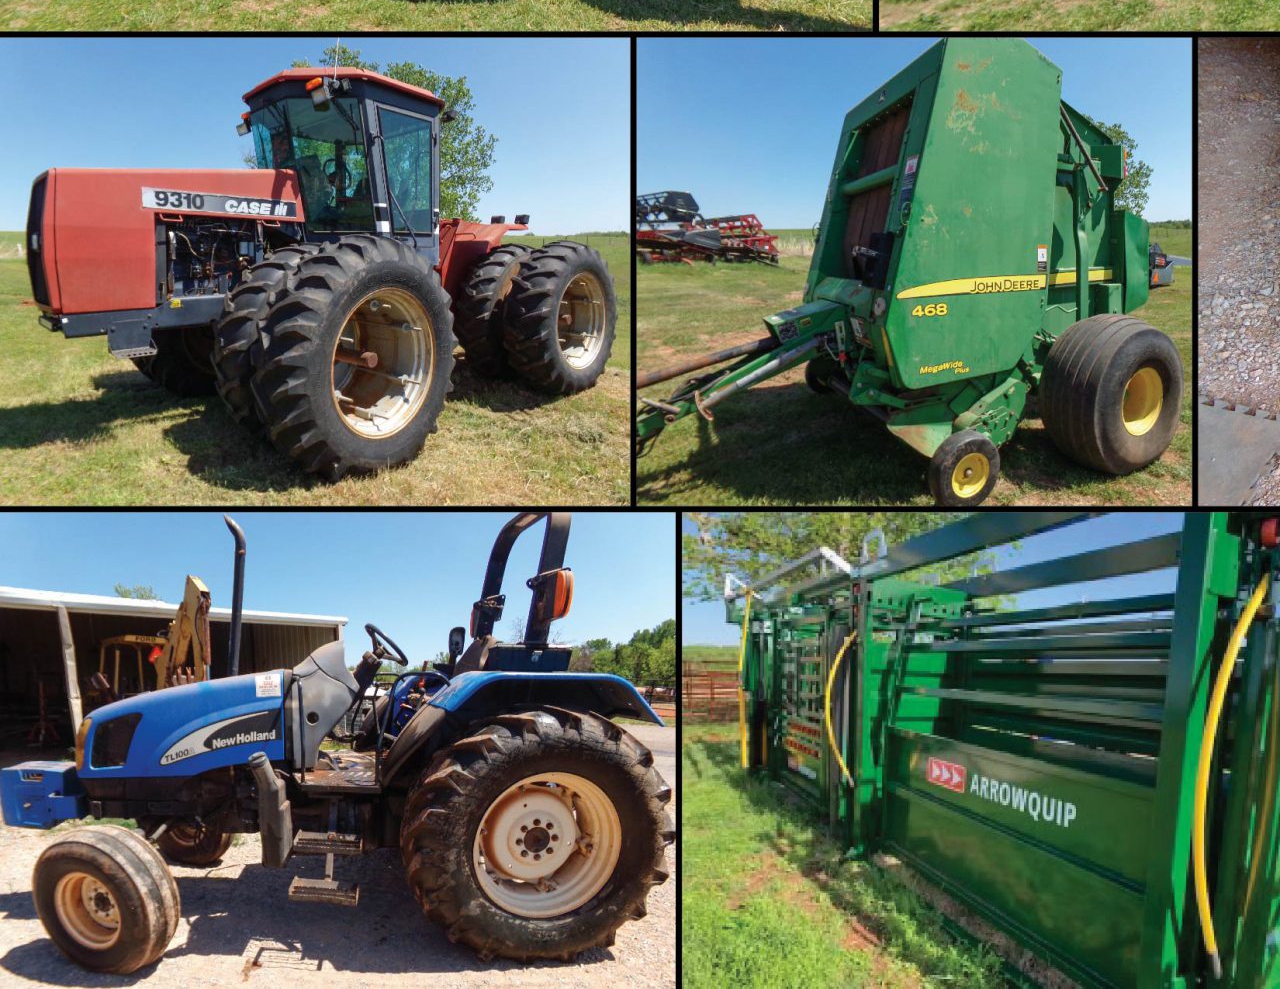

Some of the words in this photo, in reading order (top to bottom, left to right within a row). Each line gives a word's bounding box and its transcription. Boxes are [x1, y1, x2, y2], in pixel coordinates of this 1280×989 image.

[154, 190, 205, 210] 9310
[224, 199, 272, 216] CASE
[970, 280, 1003, 293] JOHN
[1003, 279, 1040, 291] DEERE
[911, 303, 948, 317] 468
[919, 360, 963, 375] MegaWide
[954, 367, 970, 375] Plus
[212, 735, 236, 750] New
[237, 729, 276, 744] Holland
[970, 773, 1077, 828] ARROWQUIP
